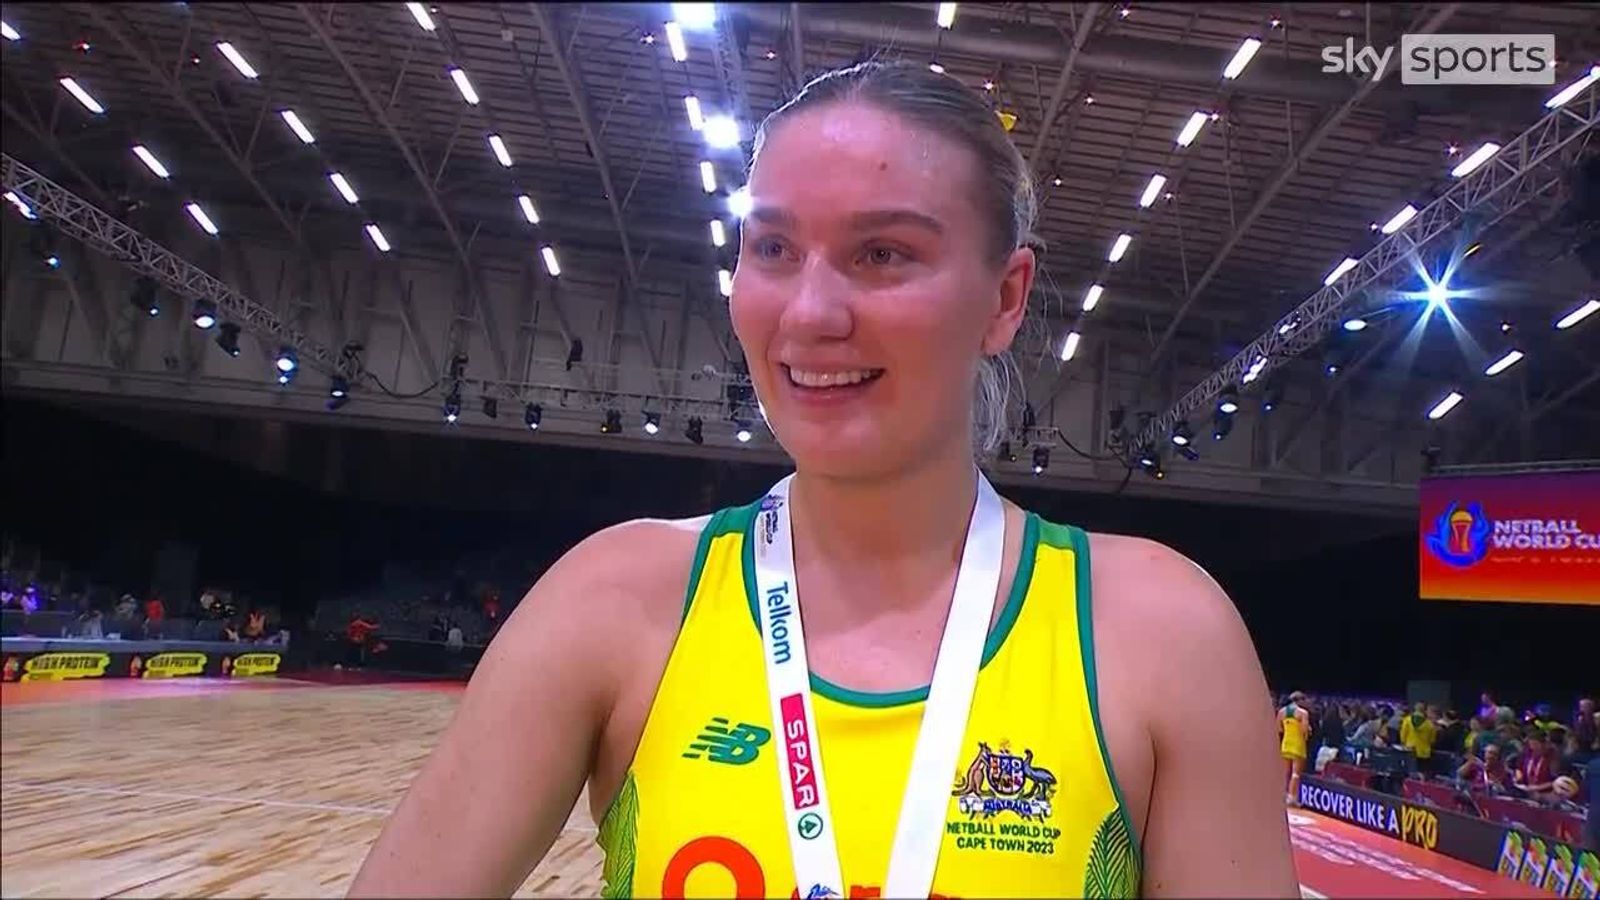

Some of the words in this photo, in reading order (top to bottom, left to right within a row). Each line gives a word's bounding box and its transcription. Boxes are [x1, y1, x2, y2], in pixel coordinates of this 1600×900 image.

[1494, 519, 1581, 534] NETBALL
[1493, 533, 1571, 549] WORLD
[1574, 533, 1600, 549] CU
[766, 581, 792, 665] Telkom
[786, 718, 815, 808] SPAR
[1301, 784, 1354, 821] RECOVER
[1355, 799, 1385, 830] LIKE
[1387, 808, 1400, 834] A
[1401, 804, 1438, 850] PRO
[946, 822, 996, 836] NETBALL
[1000, 824, 1041, 839] WORLD
[1042, 827, 1062, 840] CUP
[956, 836, 987, 851] CAPE
[989, 838, 1025, 852] TOWN
[1026, 841, 1055, 855] 2023
